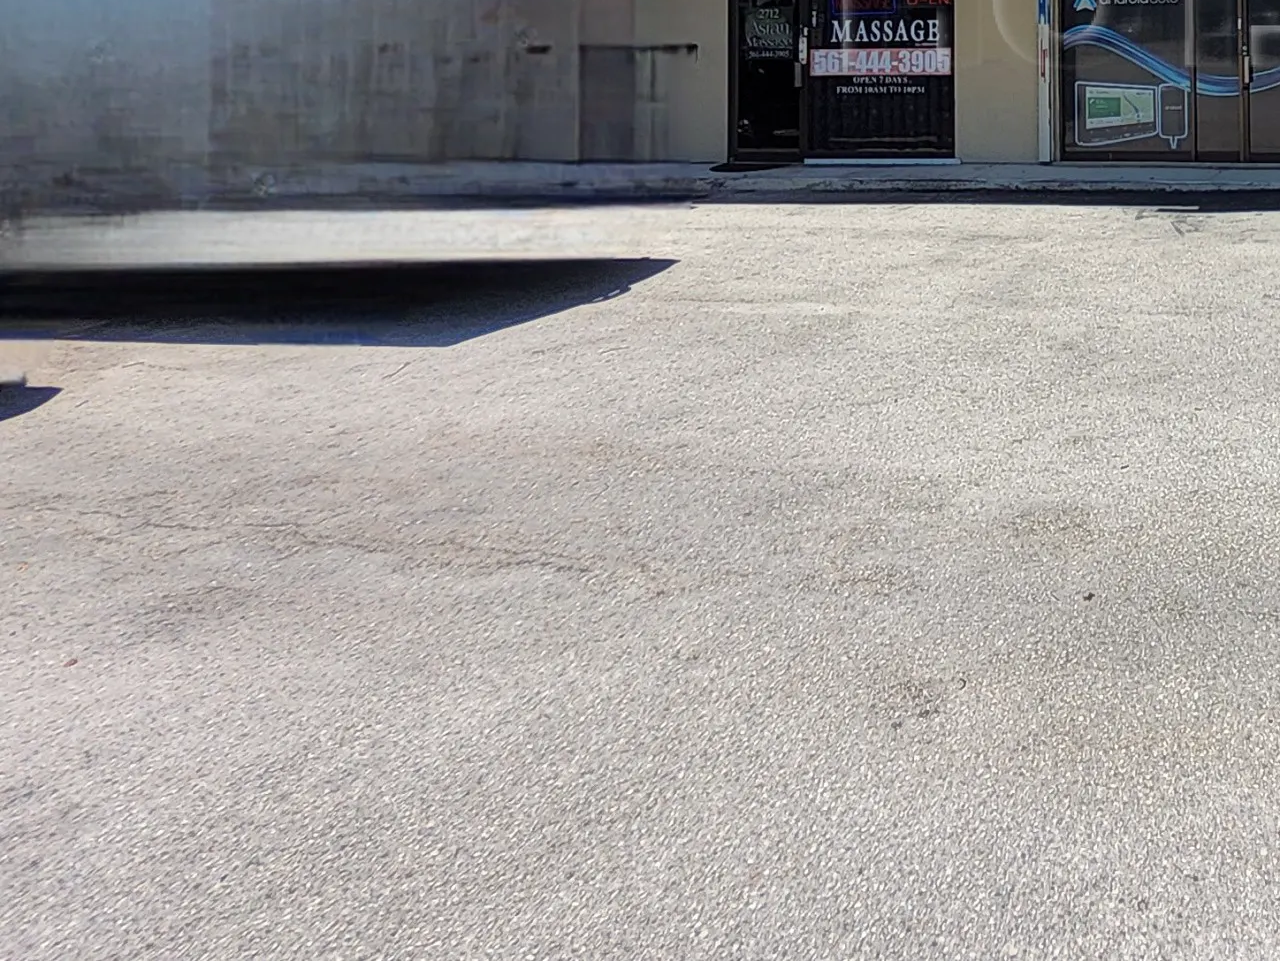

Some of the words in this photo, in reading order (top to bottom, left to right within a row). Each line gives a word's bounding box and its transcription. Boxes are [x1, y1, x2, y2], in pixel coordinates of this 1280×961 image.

[755, 7, 780, 19] 2712
[750, 20, 790, 36] Asian
[830, 19, 940, 43] MASSAGE
[813, 49, 950, 74] 561-444-3905
[852, 76, 877, 84] OPEN
[879, 76, 884, 84] 7
[836, 86, 863, 94] FROM
[888, 86, 902, 94] TO
